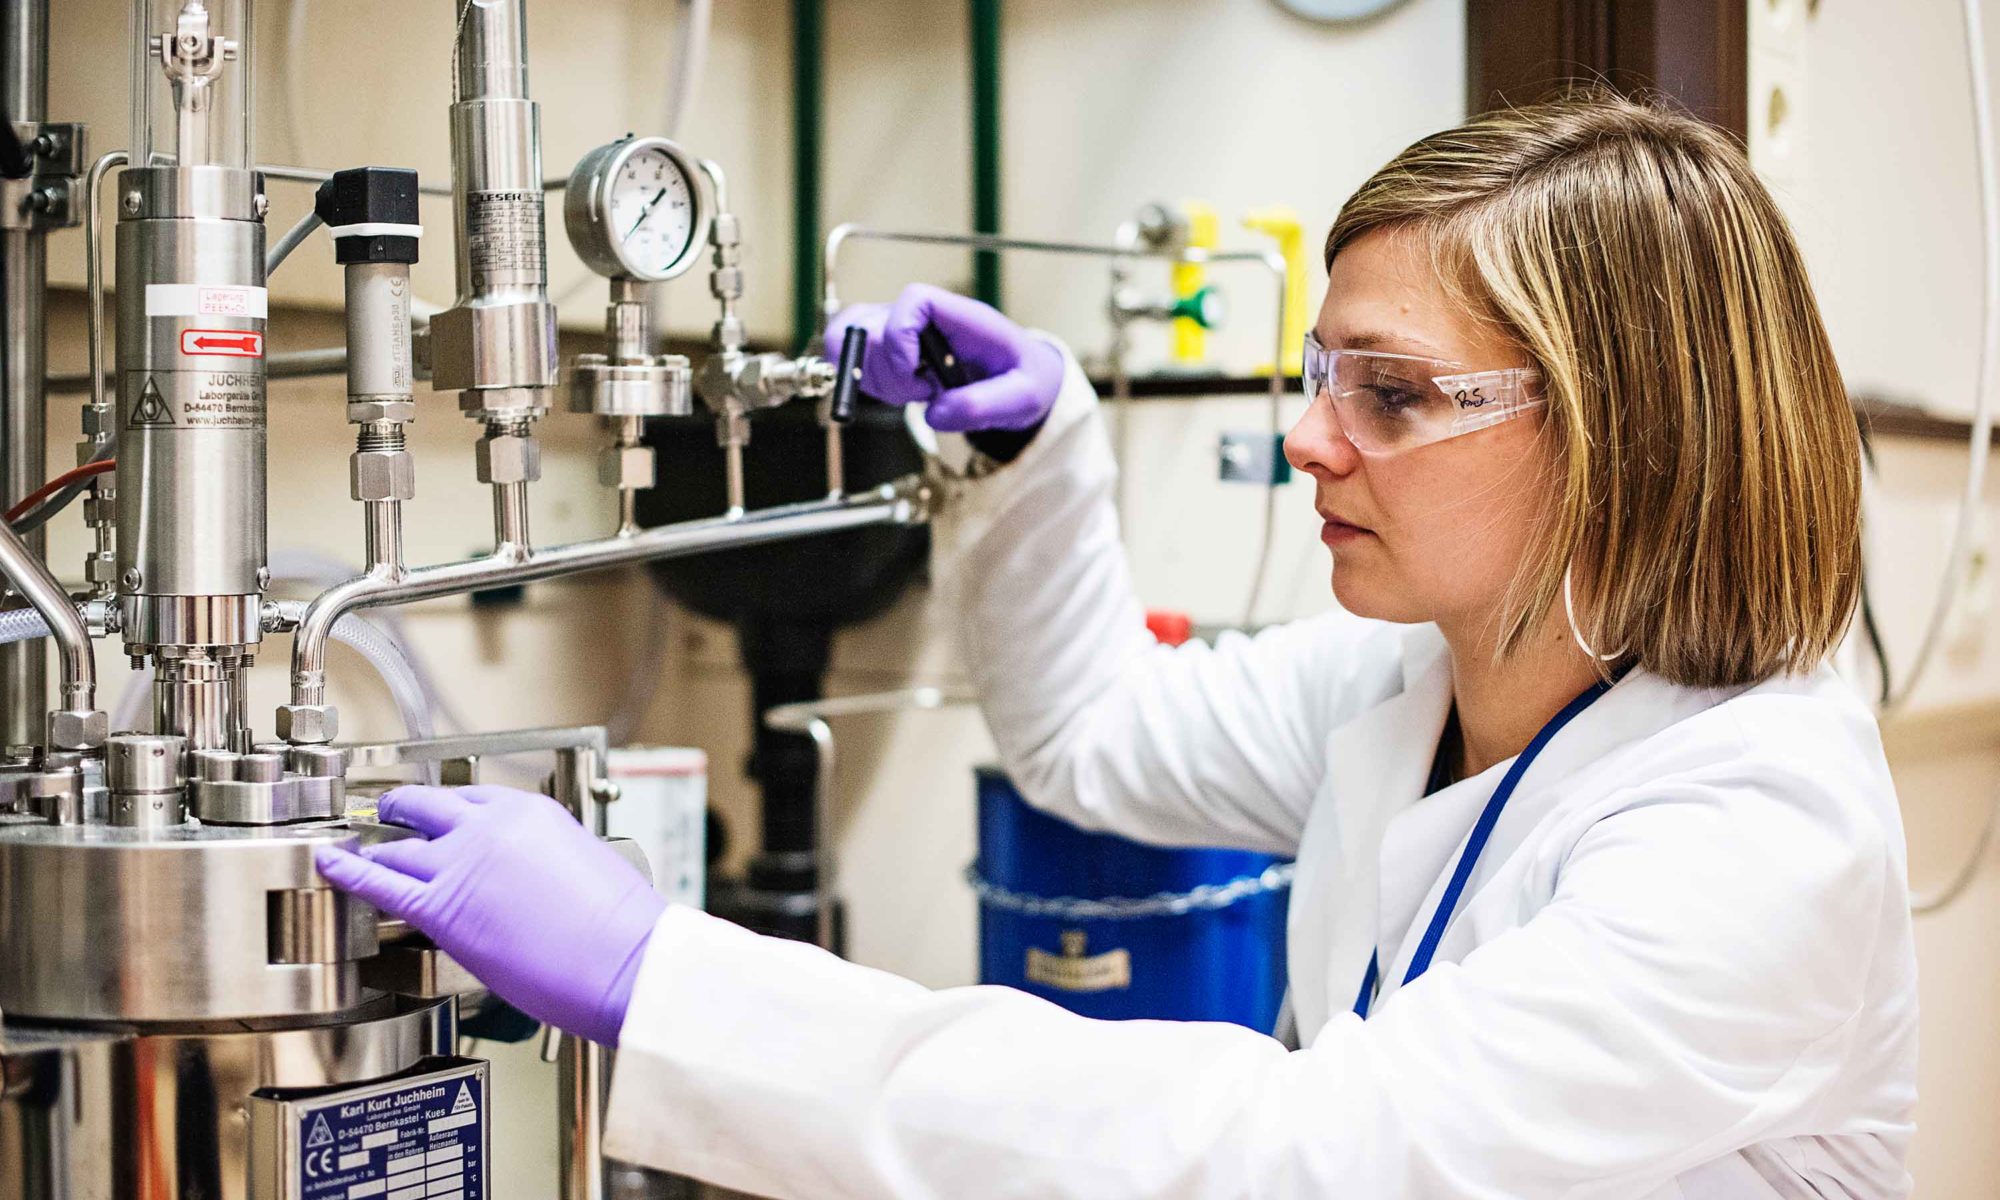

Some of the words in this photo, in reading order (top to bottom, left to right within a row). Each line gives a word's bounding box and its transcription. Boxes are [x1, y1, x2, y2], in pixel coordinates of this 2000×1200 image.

[480, 192, 522, 202] LESER
[340, 1102, 364, 1118] Karl
[367, 1097, 392, 1112] Kurt
[394, 1087, 446, 1106] Juchheim
[338, 1124, 374, 1140] D-54470
[375, 1113, 419, 1131] Bernkastel
[425, 1108, 446, 1120] Kues
[305, 1147, 333, 1177] CE
[468, 1160, 477, 1168] bar
